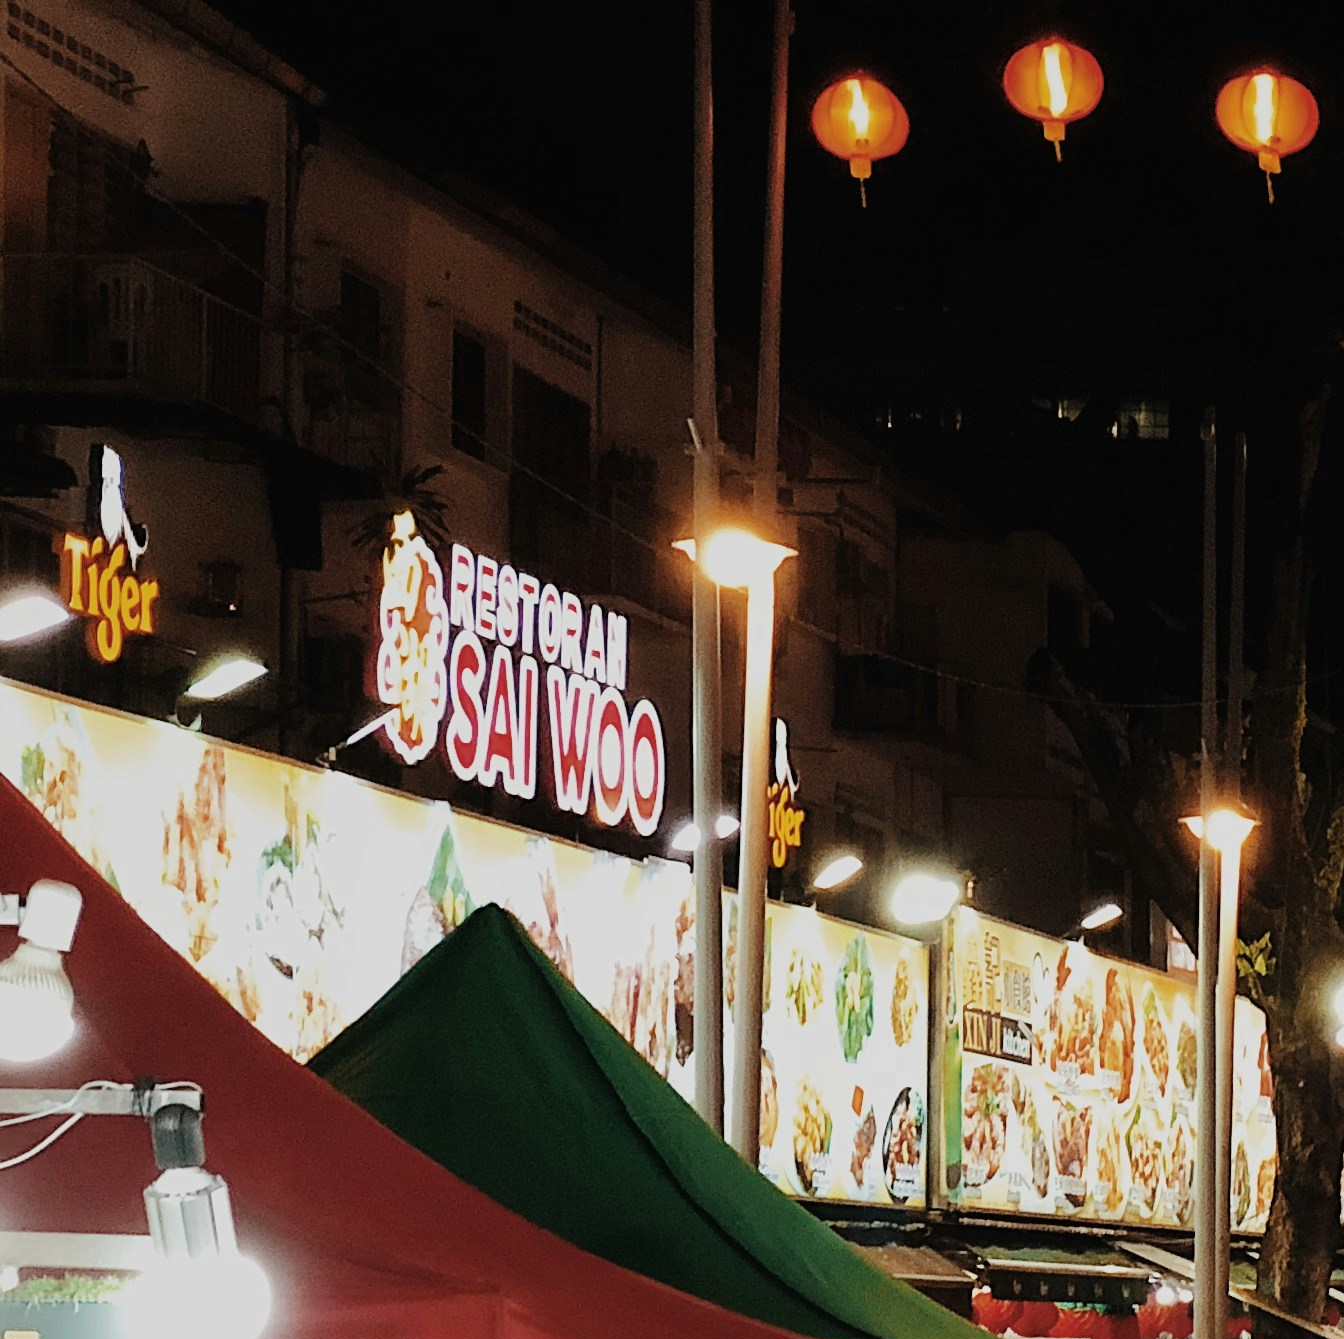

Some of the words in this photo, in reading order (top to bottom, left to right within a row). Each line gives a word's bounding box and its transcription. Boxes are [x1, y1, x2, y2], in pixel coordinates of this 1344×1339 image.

[63, 533, 159, 662] Tiger
[451, 543, 628, 690] RESTORAN
[447, 629, 539, 800] SAI
[547, 664, 665, 837] WOO
[767, 782, 805, 868] iger
[965, 1012, 988, 1051] XIN
